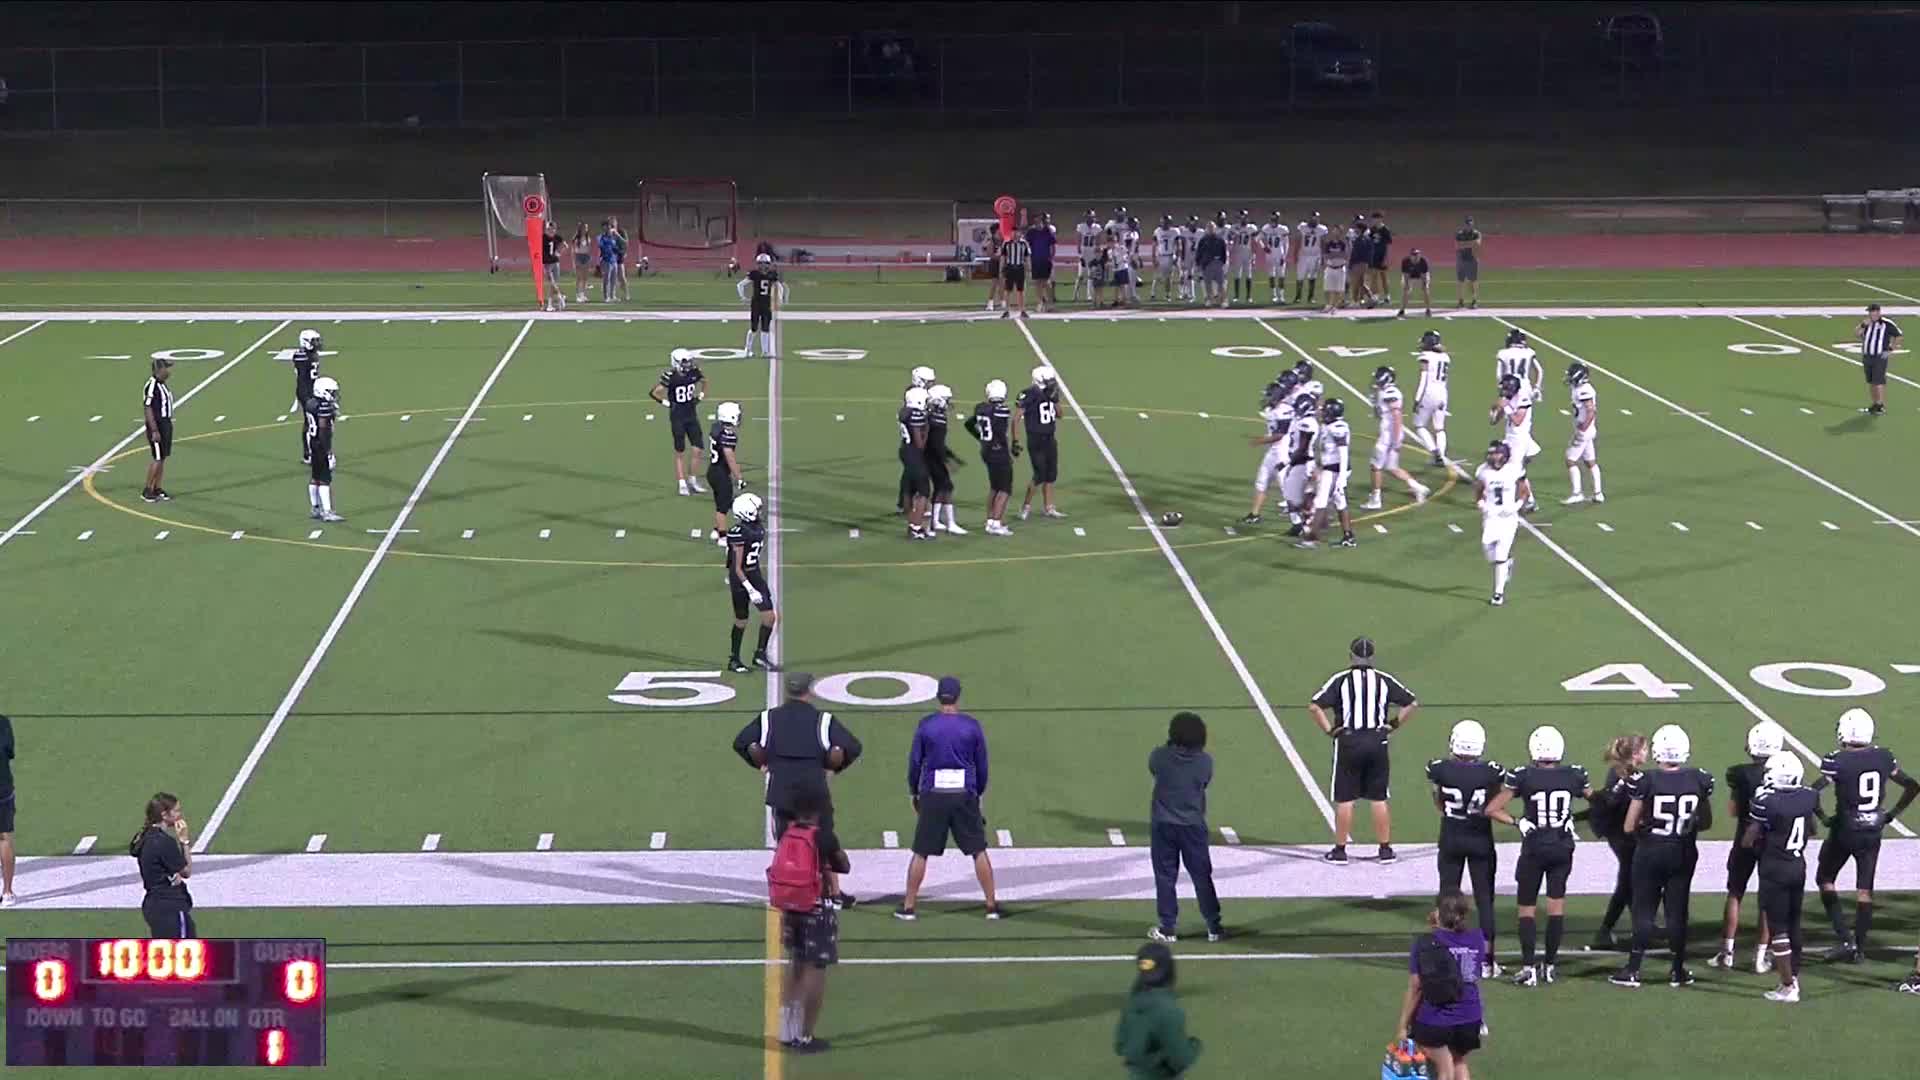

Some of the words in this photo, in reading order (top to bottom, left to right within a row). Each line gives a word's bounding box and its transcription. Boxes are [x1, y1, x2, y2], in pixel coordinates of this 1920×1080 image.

[760, 279, 769, 296] 5
[1509, 358, 1527, 379] 14
[675, 383, 695, 402] 88
[1039, 401, 1057, 424] 64
[1441, 786, 1487, 820] 24
[1857, 770, 1880, 811] 9
[1530, 790, 1571, 828] 10
[1651, 794, 1699, 836] 58
[1785, 816, 1805, 857] 4
